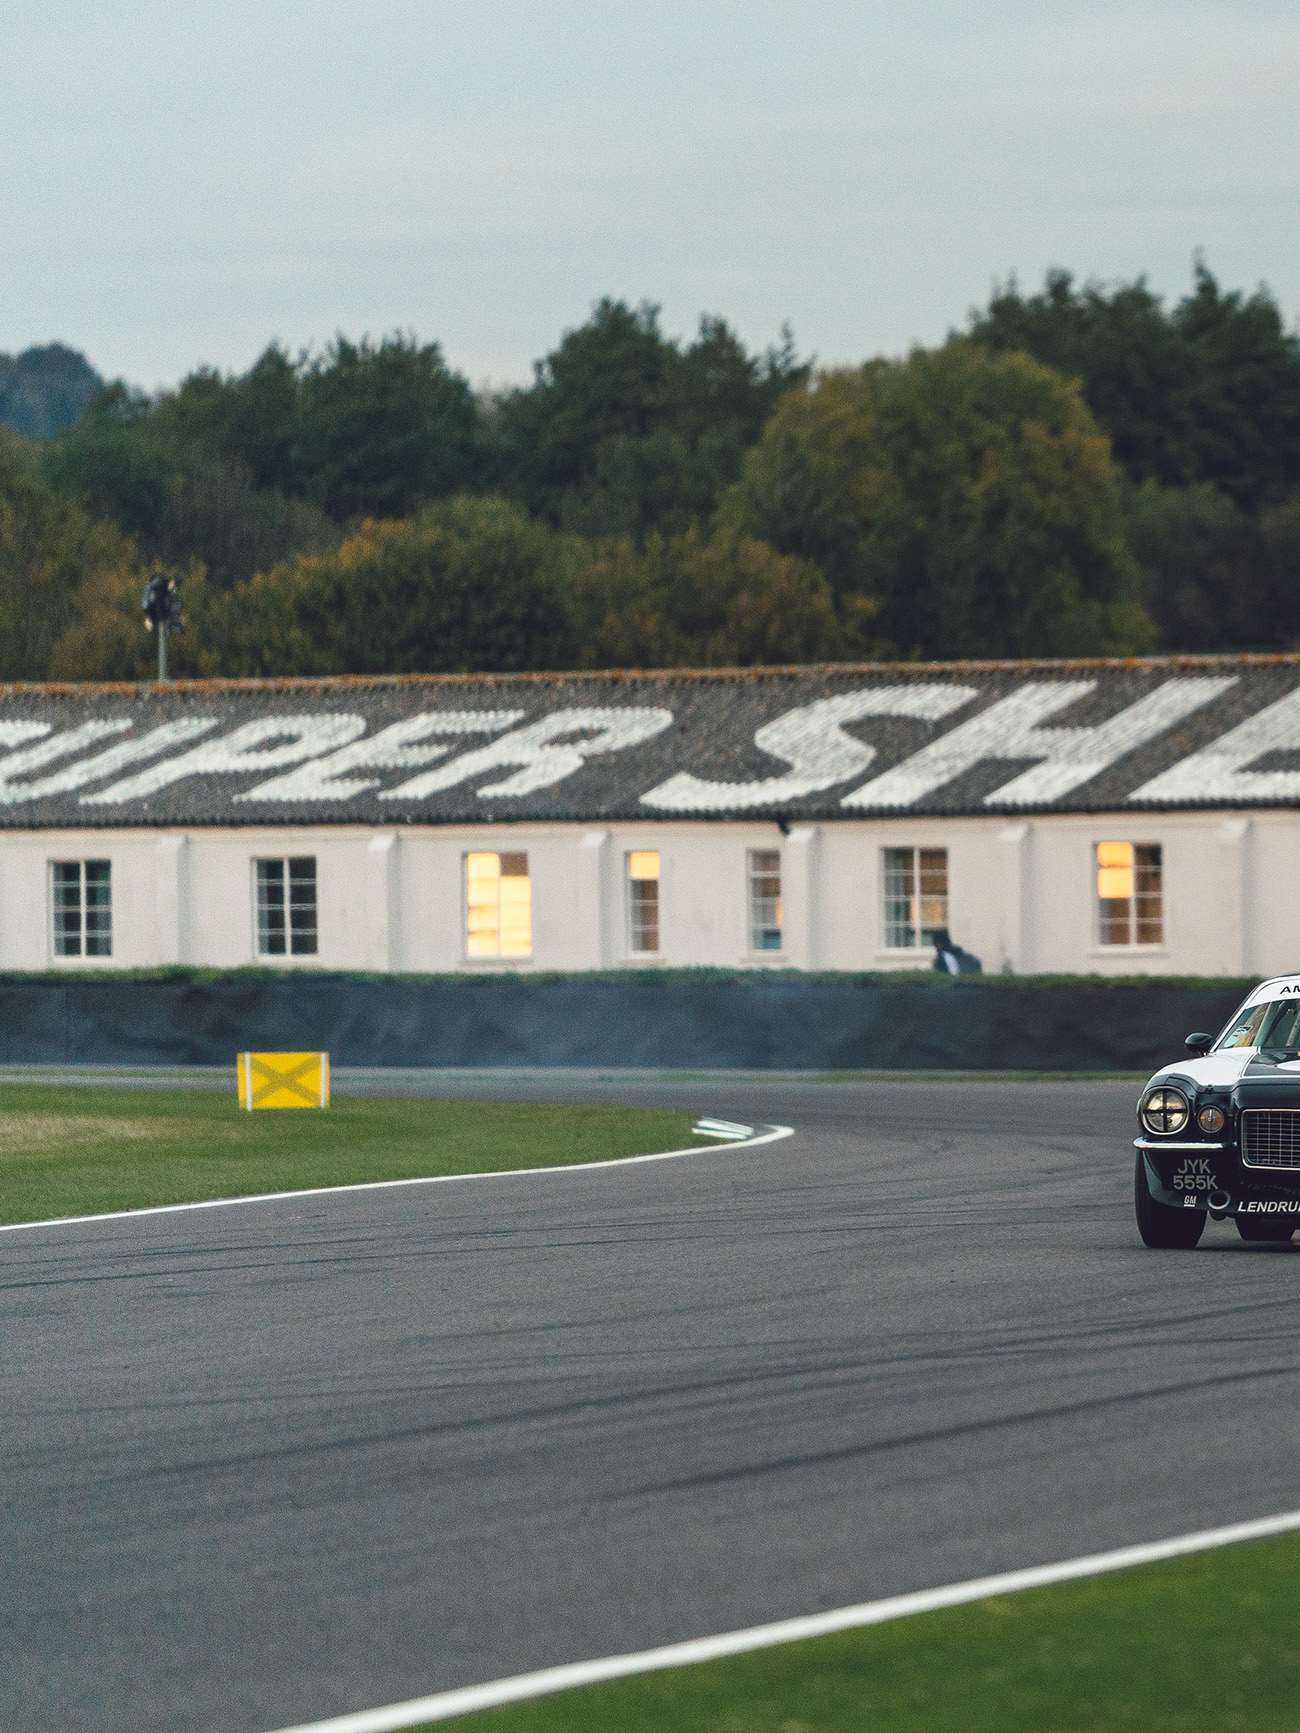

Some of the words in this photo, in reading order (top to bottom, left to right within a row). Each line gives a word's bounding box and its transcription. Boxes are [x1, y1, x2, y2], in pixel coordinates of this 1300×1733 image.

[0, 707, 672, 806] UPER
[1177, 1159, 1211, 1174] JYK
[1173, 1175, 1219, 1190] 555K
[1184, 1195, 1197, 1205] GM
